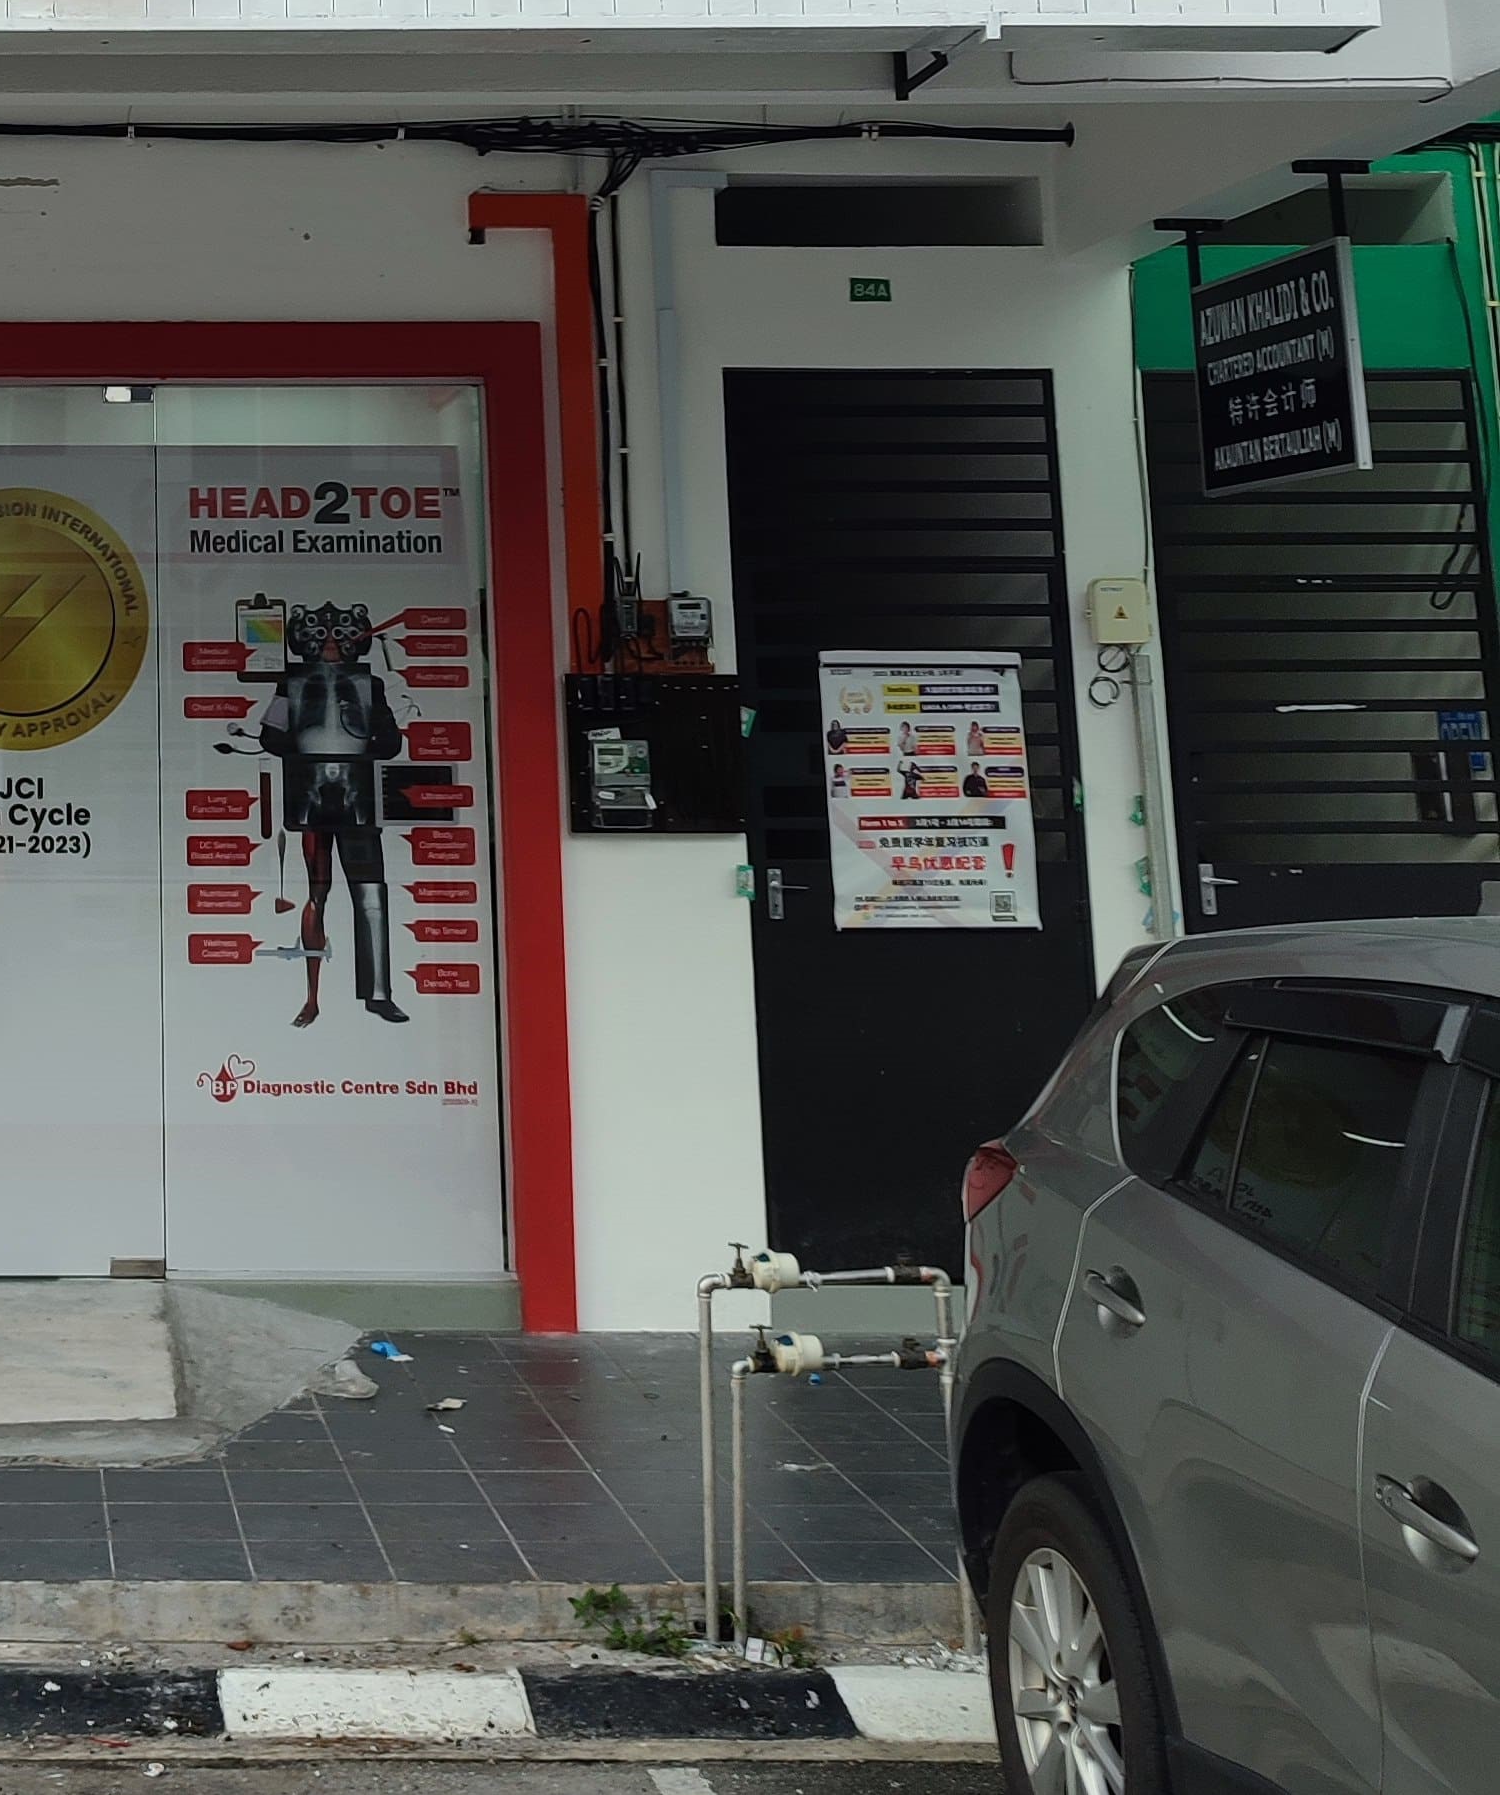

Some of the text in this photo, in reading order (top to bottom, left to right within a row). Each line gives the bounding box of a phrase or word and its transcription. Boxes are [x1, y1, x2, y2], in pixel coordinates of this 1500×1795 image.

[853, 283, 889, 297] 84A
[1299, 276, 1312, 317] &
[1311, 269, 1335, 314] CO.
[189, 529, 443, 554] Medical Examination
[41, 504, 140, 618] INTERNATIONAL
[10, 689, 117, 739] APPROVAL
[7, 802, 92, 834] Cycle
[211, 1079, 478, 1097] BP Diagnostic Centre Sdn Bhd
